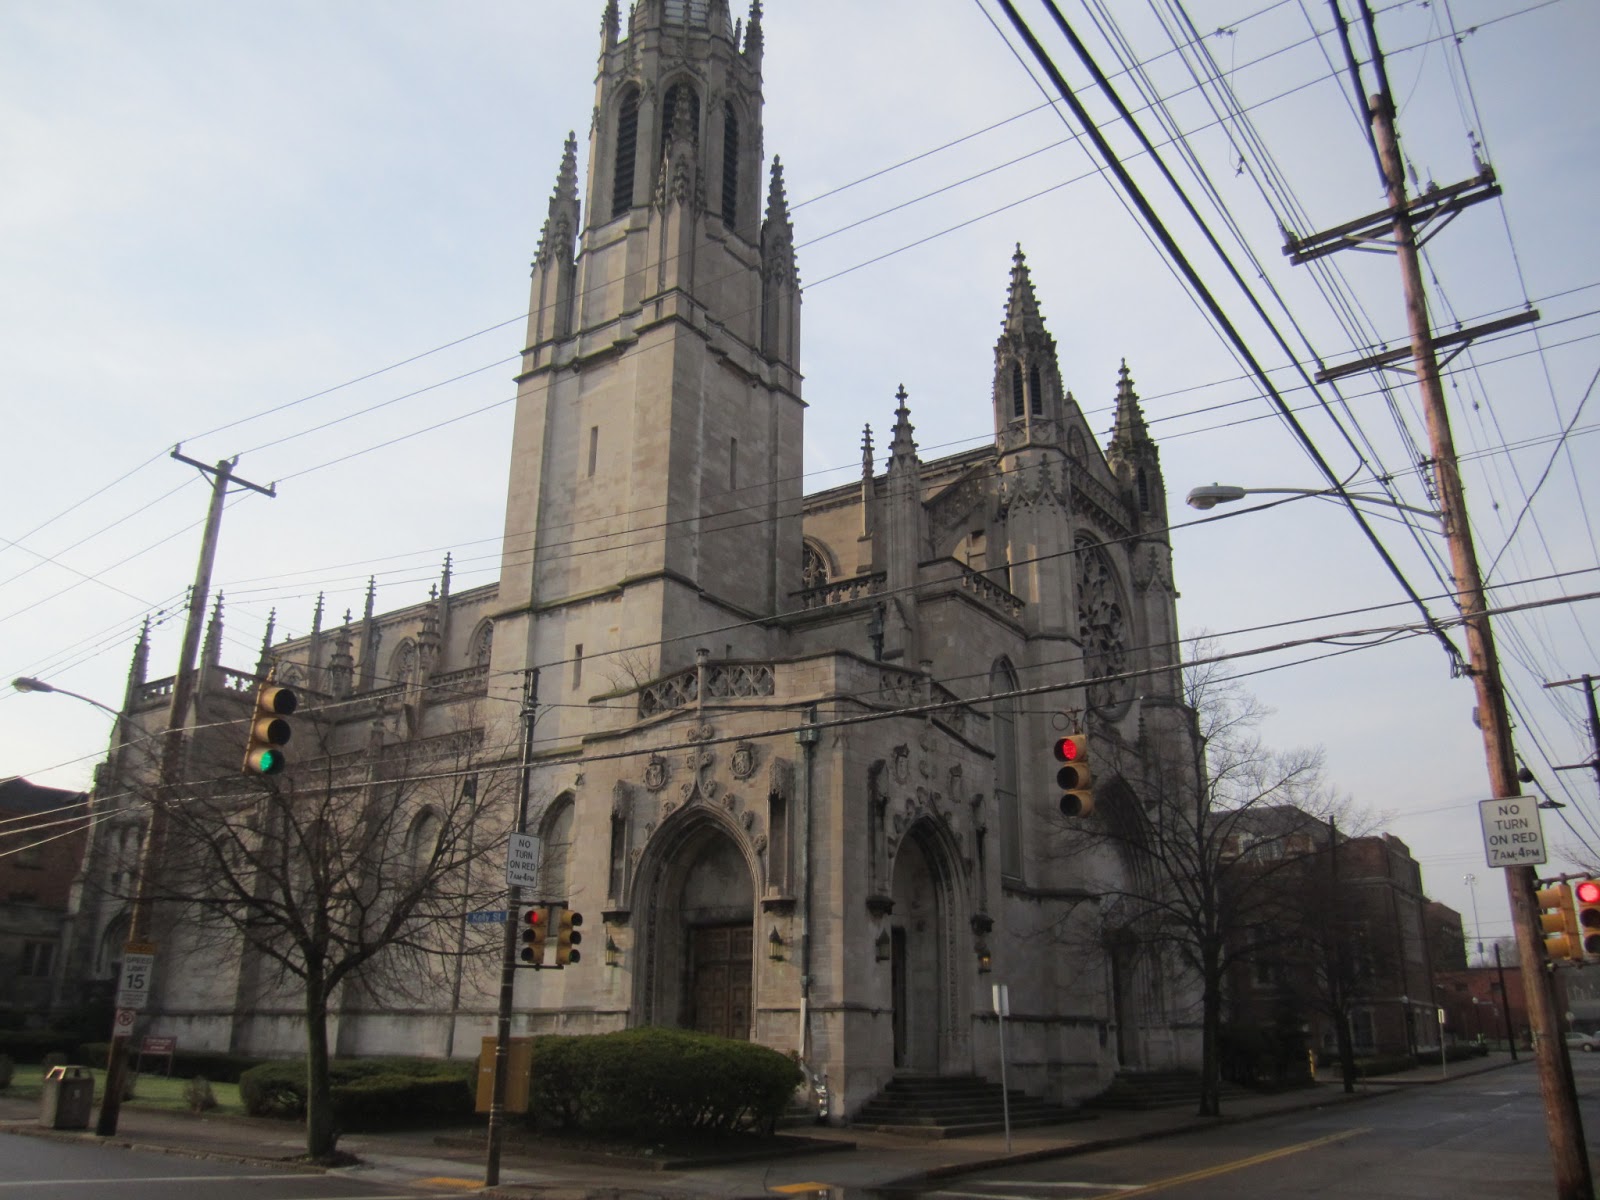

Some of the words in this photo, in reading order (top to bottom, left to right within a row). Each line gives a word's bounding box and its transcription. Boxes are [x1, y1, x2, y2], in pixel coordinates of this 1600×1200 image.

[1498, 804, 1520, 816] NO
[1493, 818, 1529, 830] TURN
[518, 839, 531, 849] NO
[1489, 835, 1508, 846] ON
[1511, 832, 1538, 844] RED
[515, 849, 533, 860] TURN
[509, 860, 520, 869] ON
[521, 862, 536, 872] RED
[127, 973, 145, 989] 15
